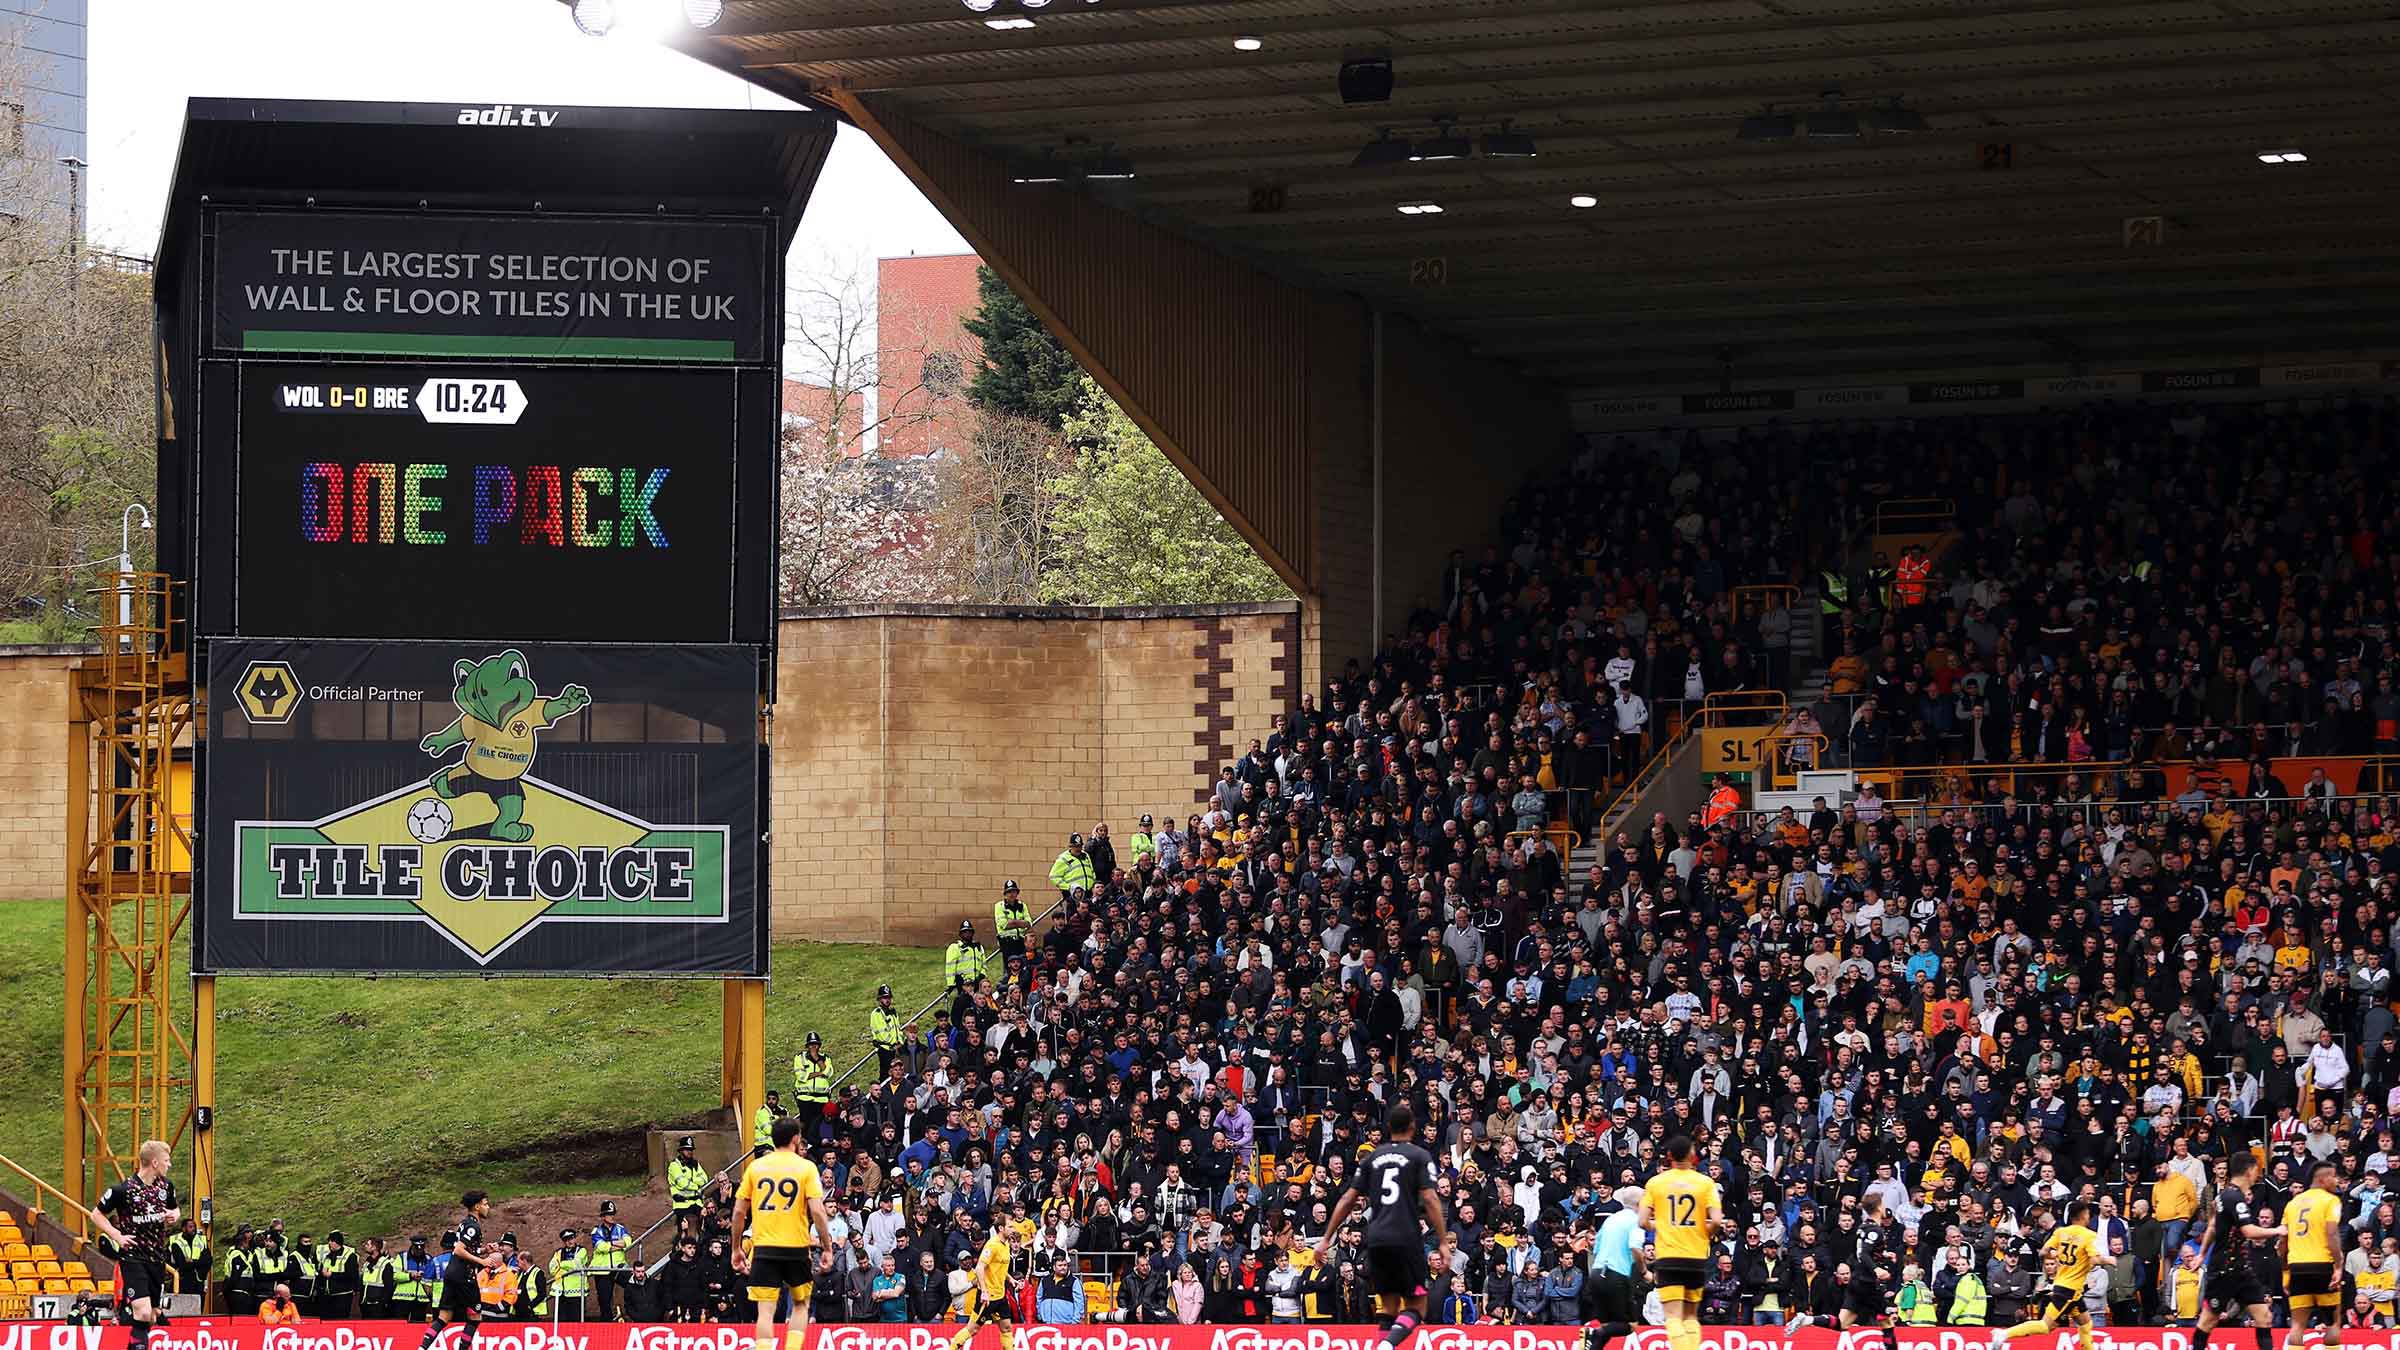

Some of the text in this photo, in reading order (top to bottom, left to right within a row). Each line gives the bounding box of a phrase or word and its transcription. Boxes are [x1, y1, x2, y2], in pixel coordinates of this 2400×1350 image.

[457, 104, 560, 127] adi.tv
[271, 249, 710, 284] THE LARGEST SELECTION OF
[244, 285, 736, 321] WALL & FLOOR TILES IN THE UK
[282, 385, 409, 409] WOL 0-0 BRE
[435, 383, 508, 414] 10:24
[301, 463, 671, 548] ONE PACK
[309, 685, 424, 701] Official Partner
[269, 844, 694, 902] TILE CHOICE
[757, 1177, 799, 1211] 29
[1381, 1167, 1400, 1205] 5
[1667, 1193, 1696, 1227] 12
[2296, 1208, 2311, 1237] 5
[2059, 1241, 2078, 1267] 35
[38, 1301, 56, 1319] 17
